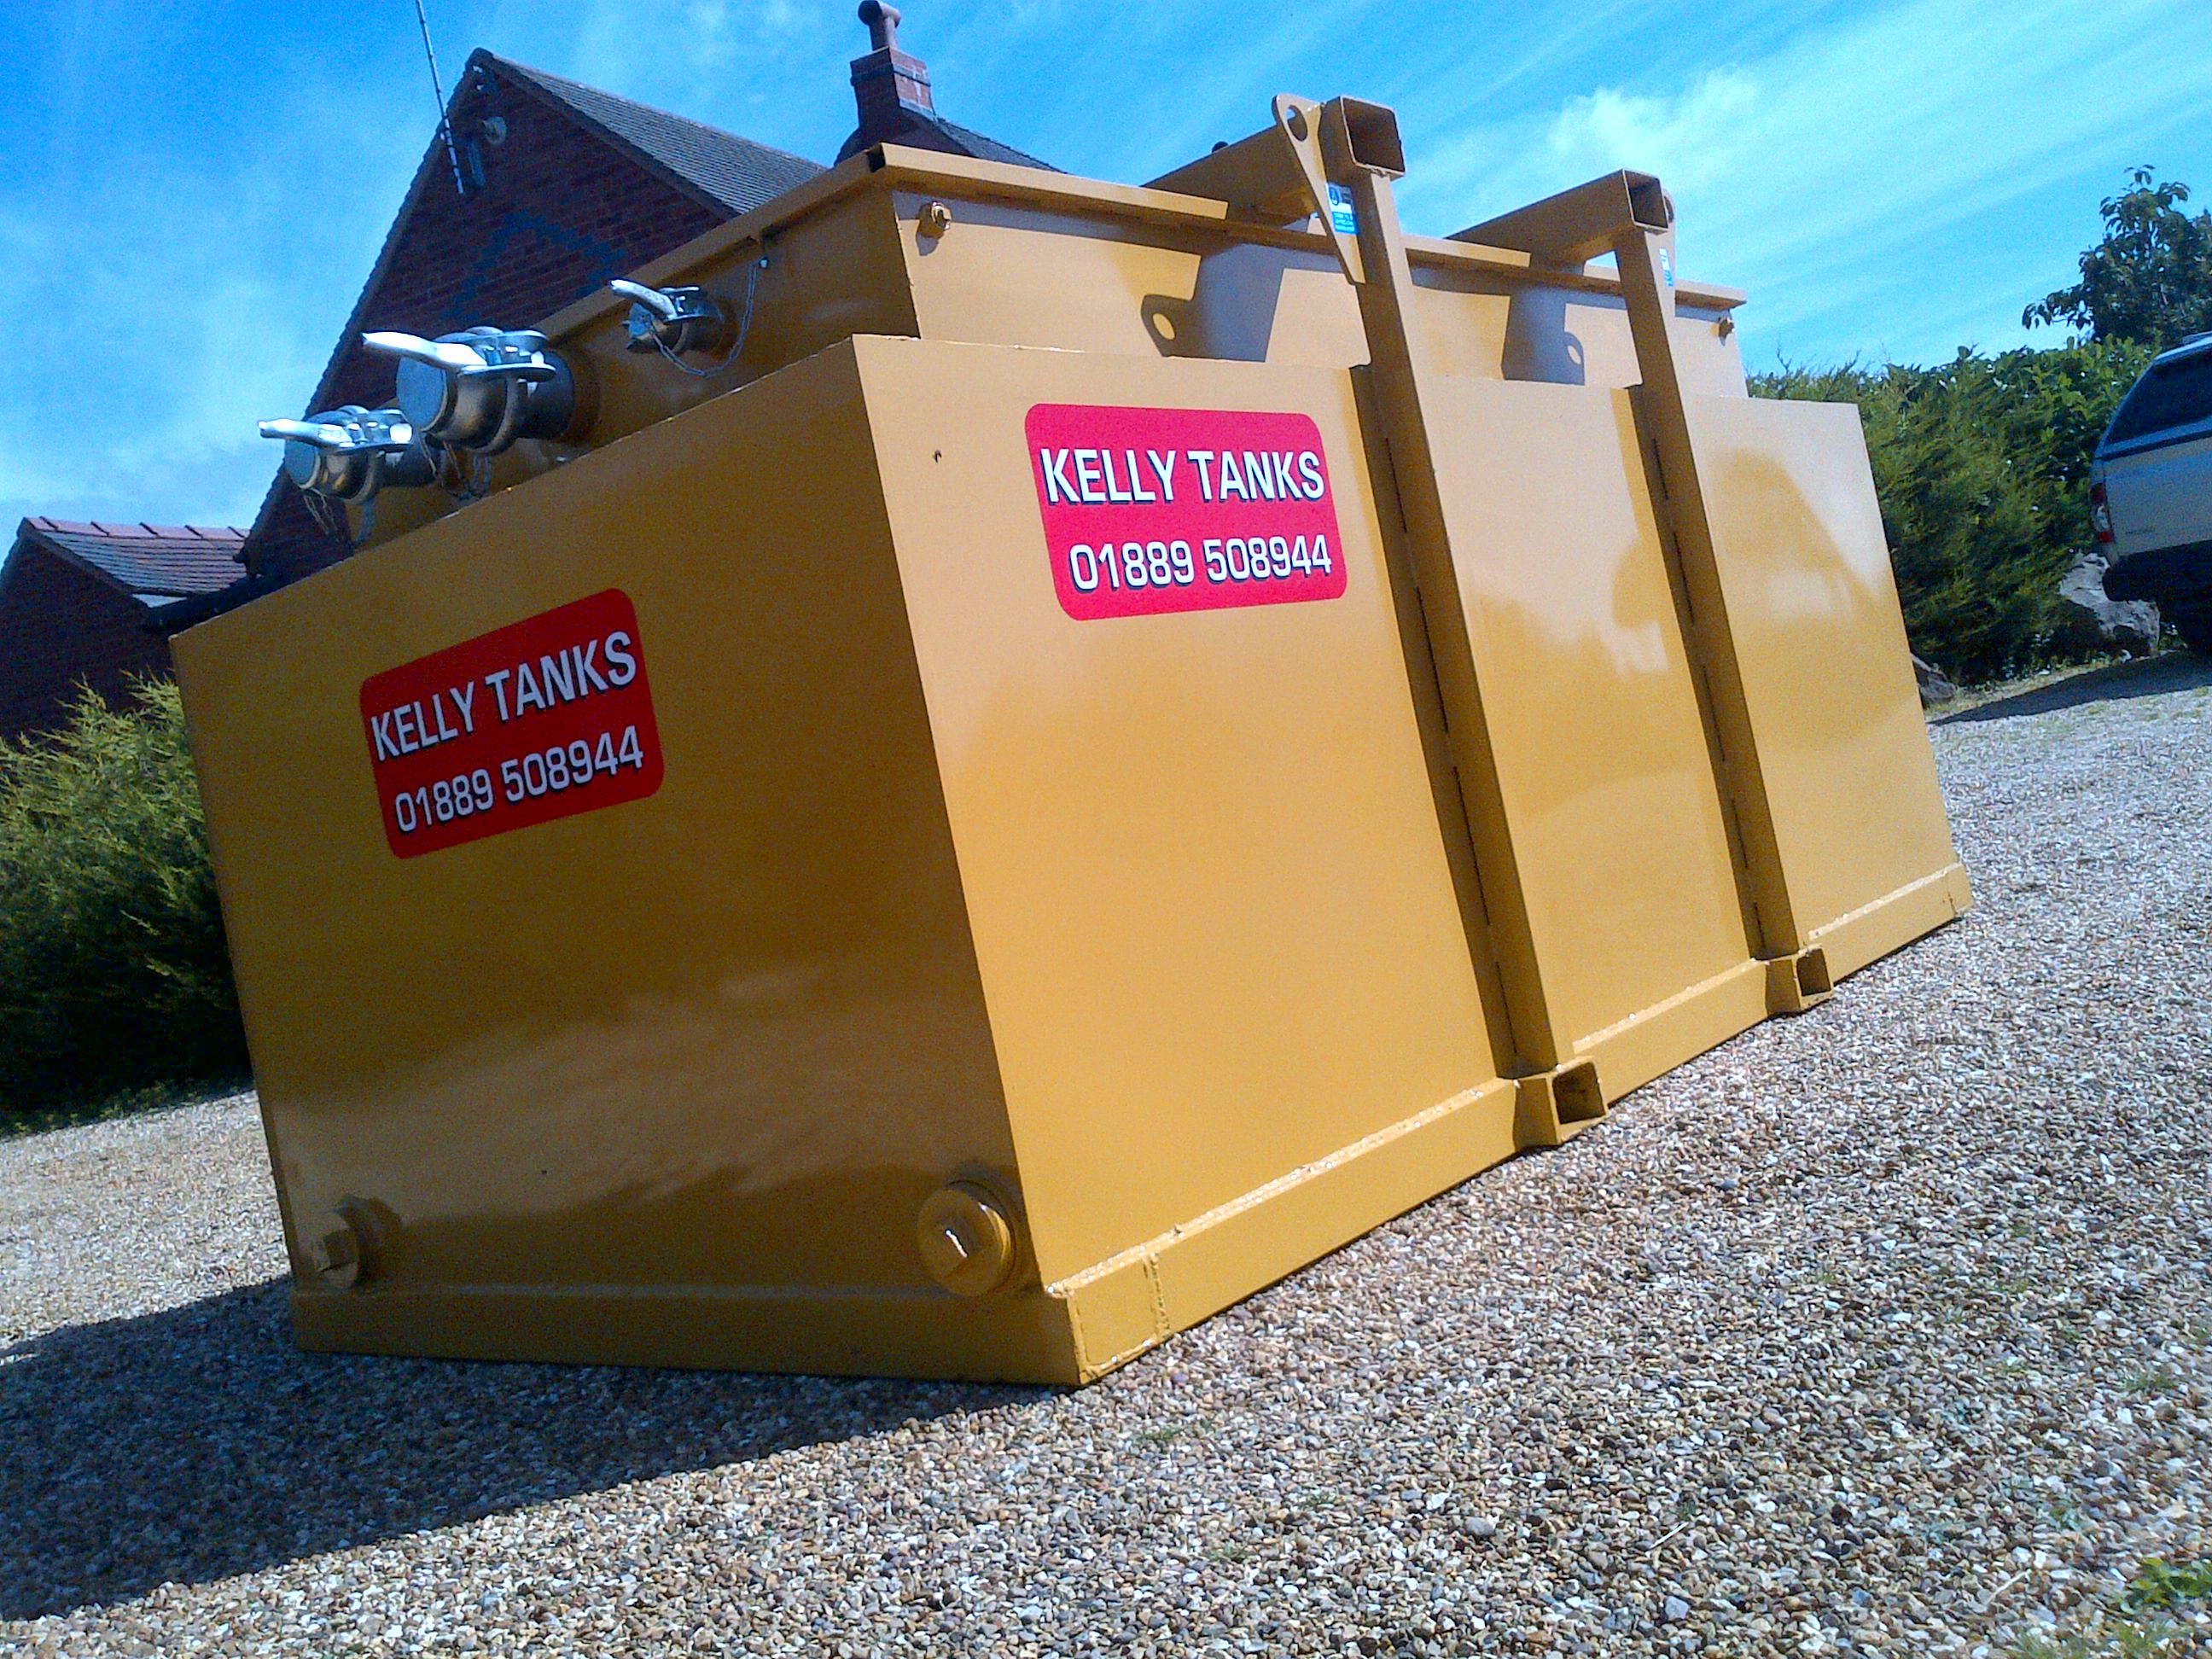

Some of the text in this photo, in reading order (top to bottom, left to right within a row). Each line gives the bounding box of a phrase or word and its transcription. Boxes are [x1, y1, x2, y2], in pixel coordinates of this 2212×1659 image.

[1040, 448, 1325, 504] KELLY TANKS
[1068, 534, 1332, 593] 01889 508944
[370, 631, 637, 761] KELLY TANKS
[394, 725, 643, 833] 01889 508944
